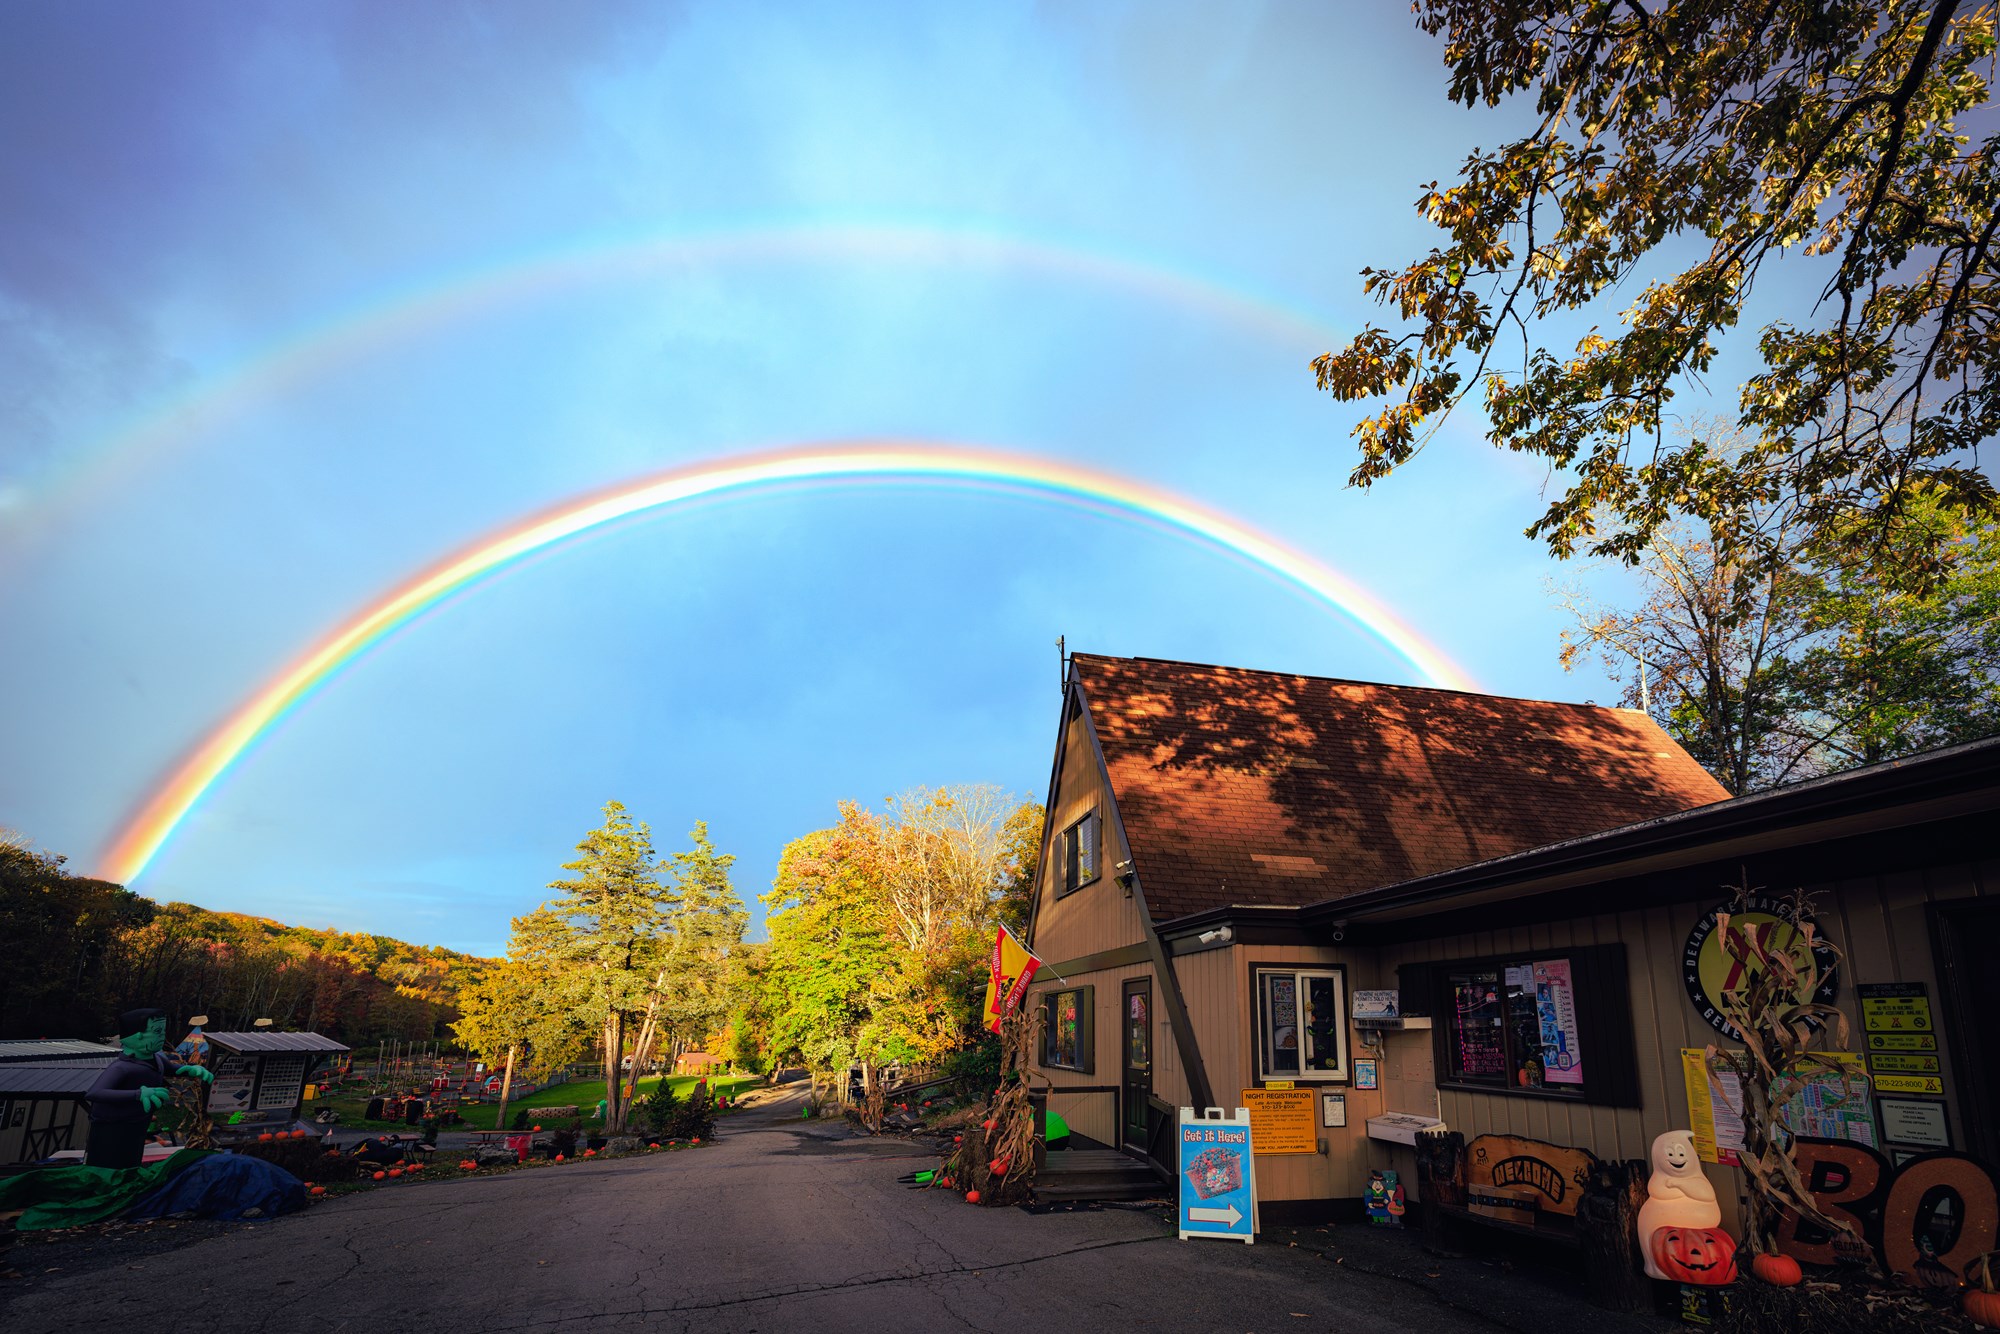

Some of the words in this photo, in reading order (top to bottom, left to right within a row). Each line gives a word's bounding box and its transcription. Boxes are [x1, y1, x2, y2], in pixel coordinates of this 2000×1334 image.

[1686, 901, 1738, 967] DELAWARE
[1019, 970, 1032, 988] AWARD
[1877, 1079, 1923, 1088] 570-223-8000
[1184, 1129, 1202, 1142] Get
[1204, 1130, 1215, 1142] it
[1217, 1130, 1246, 1143] Here!
[1494, 1160, 1563, 1202] WELCOME
